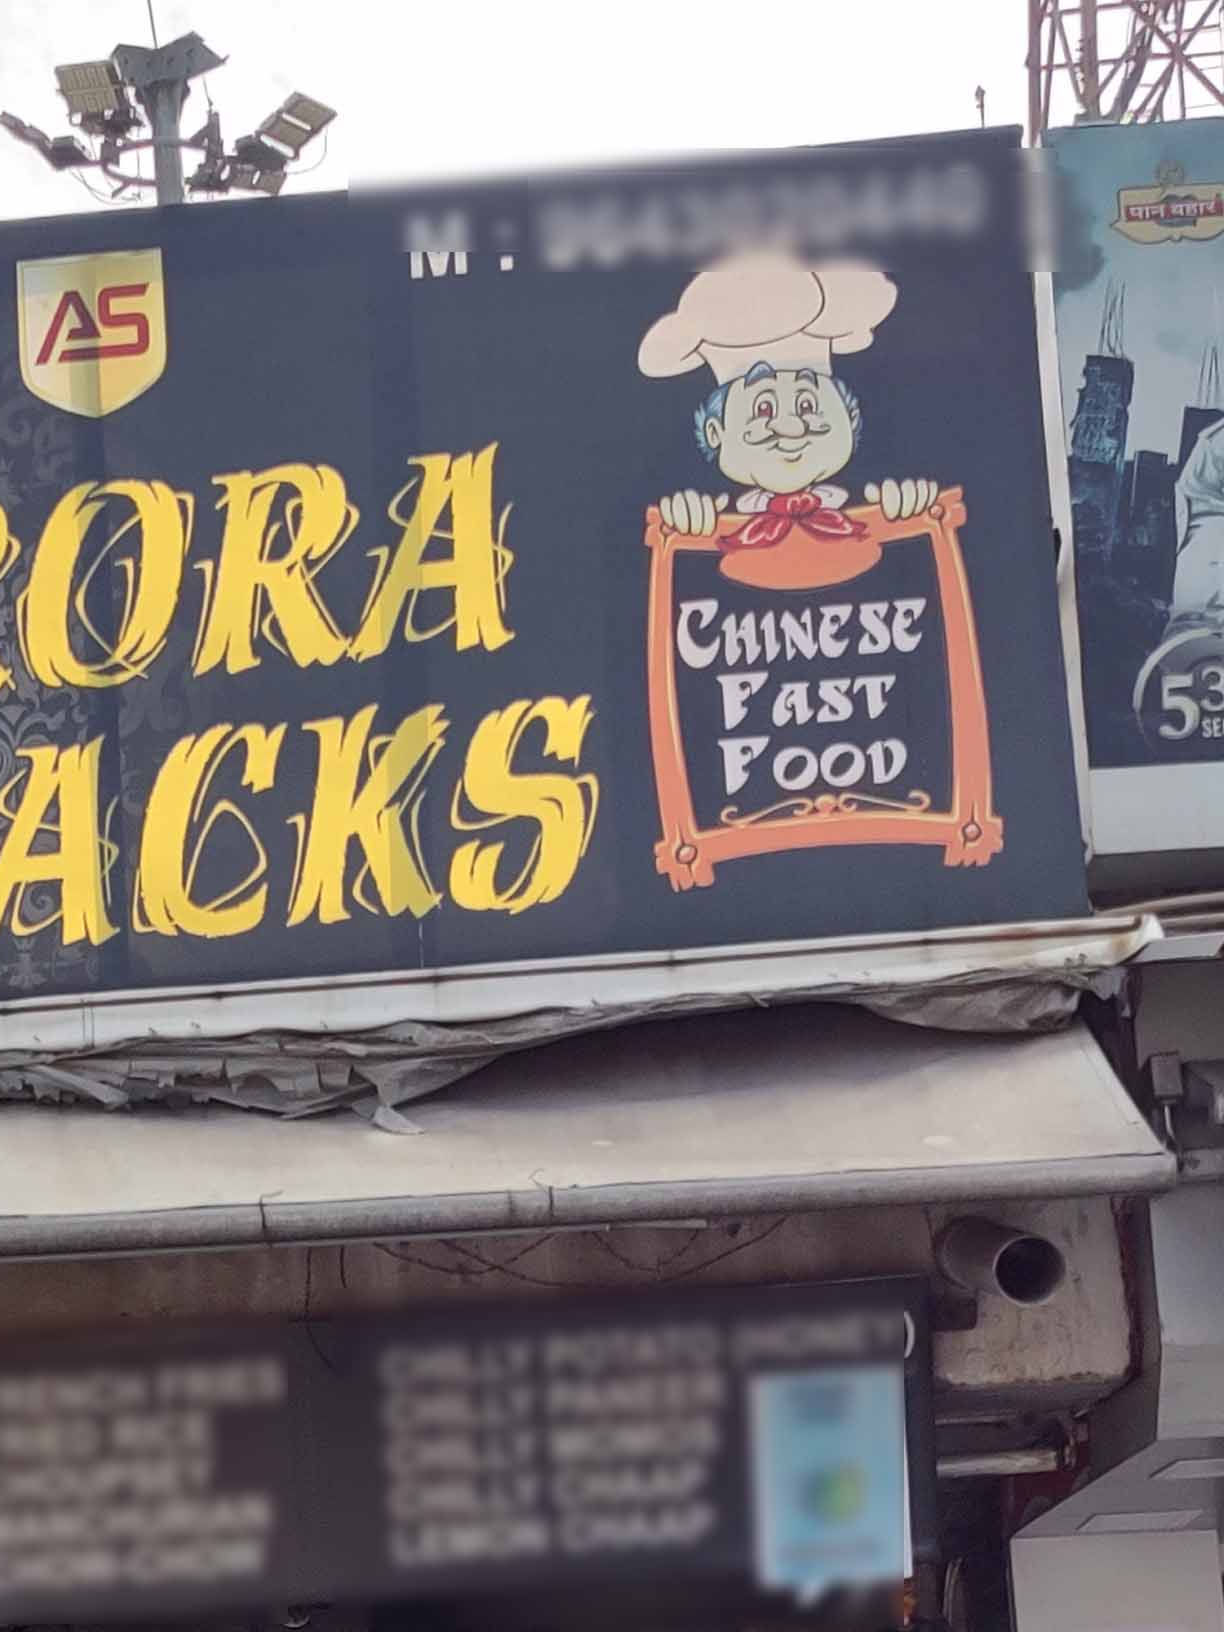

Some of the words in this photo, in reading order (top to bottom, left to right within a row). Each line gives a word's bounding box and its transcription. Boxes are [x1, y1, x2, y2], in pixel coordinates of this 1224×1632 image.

[35, 282, 150, 366] AS
[716, 671, 896, 730] FAST
[717, 736, 908, 796] FOOD
